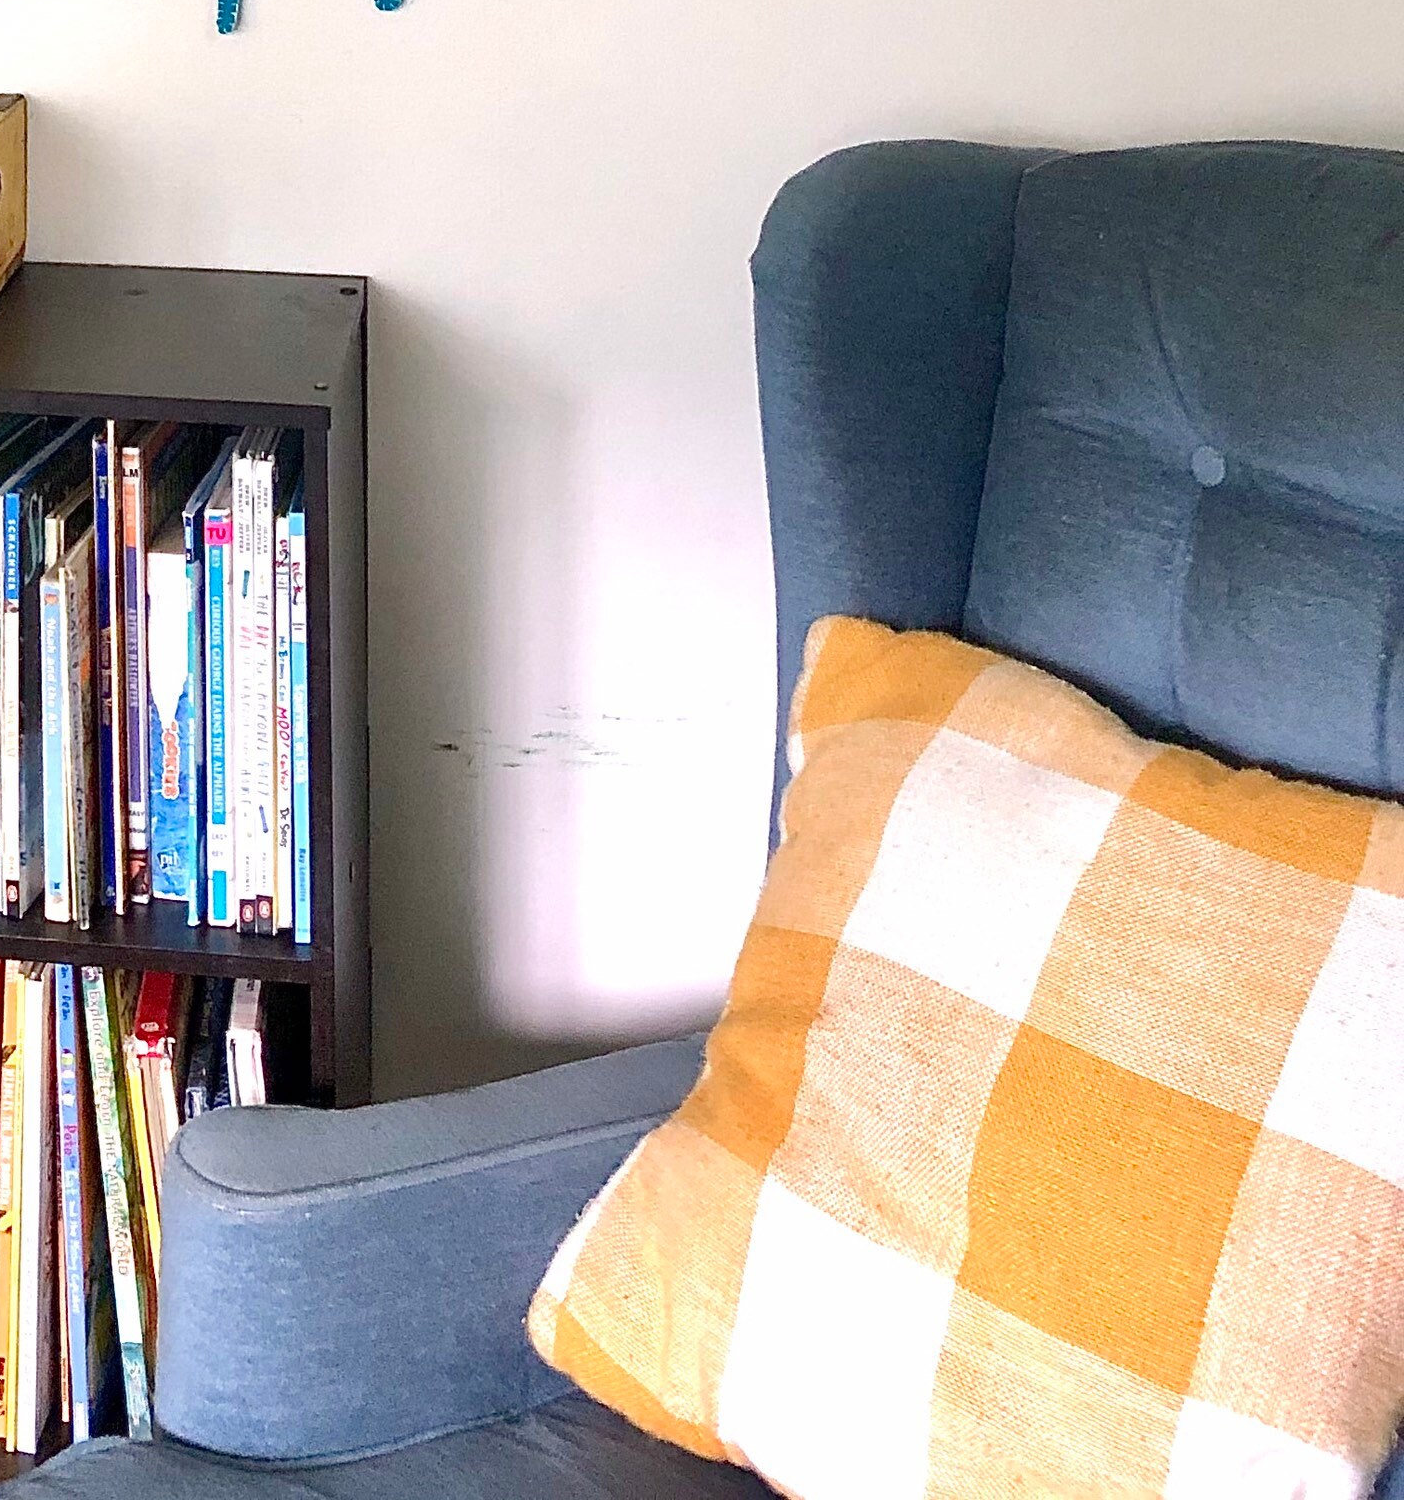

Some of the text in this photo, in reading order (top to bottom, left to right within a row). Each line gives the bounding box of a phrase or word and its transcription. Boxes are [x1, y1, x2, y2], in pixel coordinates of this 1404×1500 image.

[7, 518, 17, 591] SCHACHNER
[206, 526, 227, 540] TU
[211, 595, 222, 645] CURIOUS
[46, 617, 59, 736] Noah and the Ark
[212, 647, 223, 693] GEORGE
[212, 694, 224, 734] LEARNS
[213, 736, 224, 758] THE
[213, 760, 225, 814] ALPHABET
[61, 994, 72, 1021] Dean
[87, 990, 130, 1276] Explore and Learn THE NATURAL WORLD
